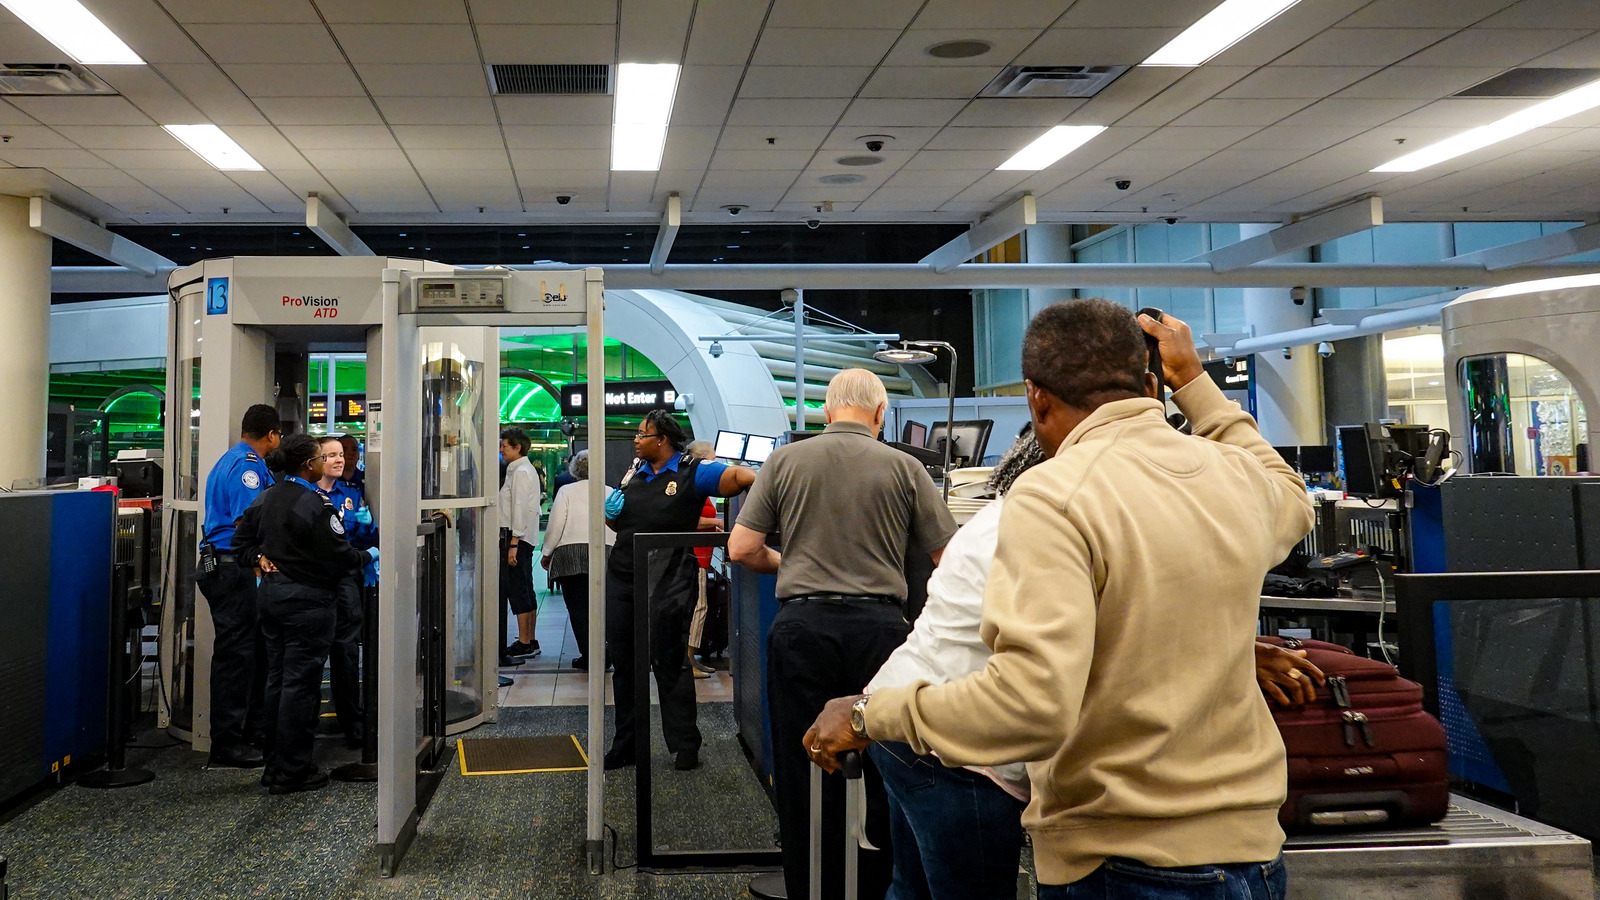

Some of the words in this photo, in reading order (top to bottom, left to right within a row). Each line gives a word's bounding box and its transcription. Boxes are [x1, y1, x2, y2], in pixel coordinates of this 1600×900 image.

[208, 284, 227, 310] 13
[282, 296, 338, 307] ProVision
[313, 307, 338, 319] ATD
[605, 393, 626, 404] Not
[627, 392, 656, 404] Enter
